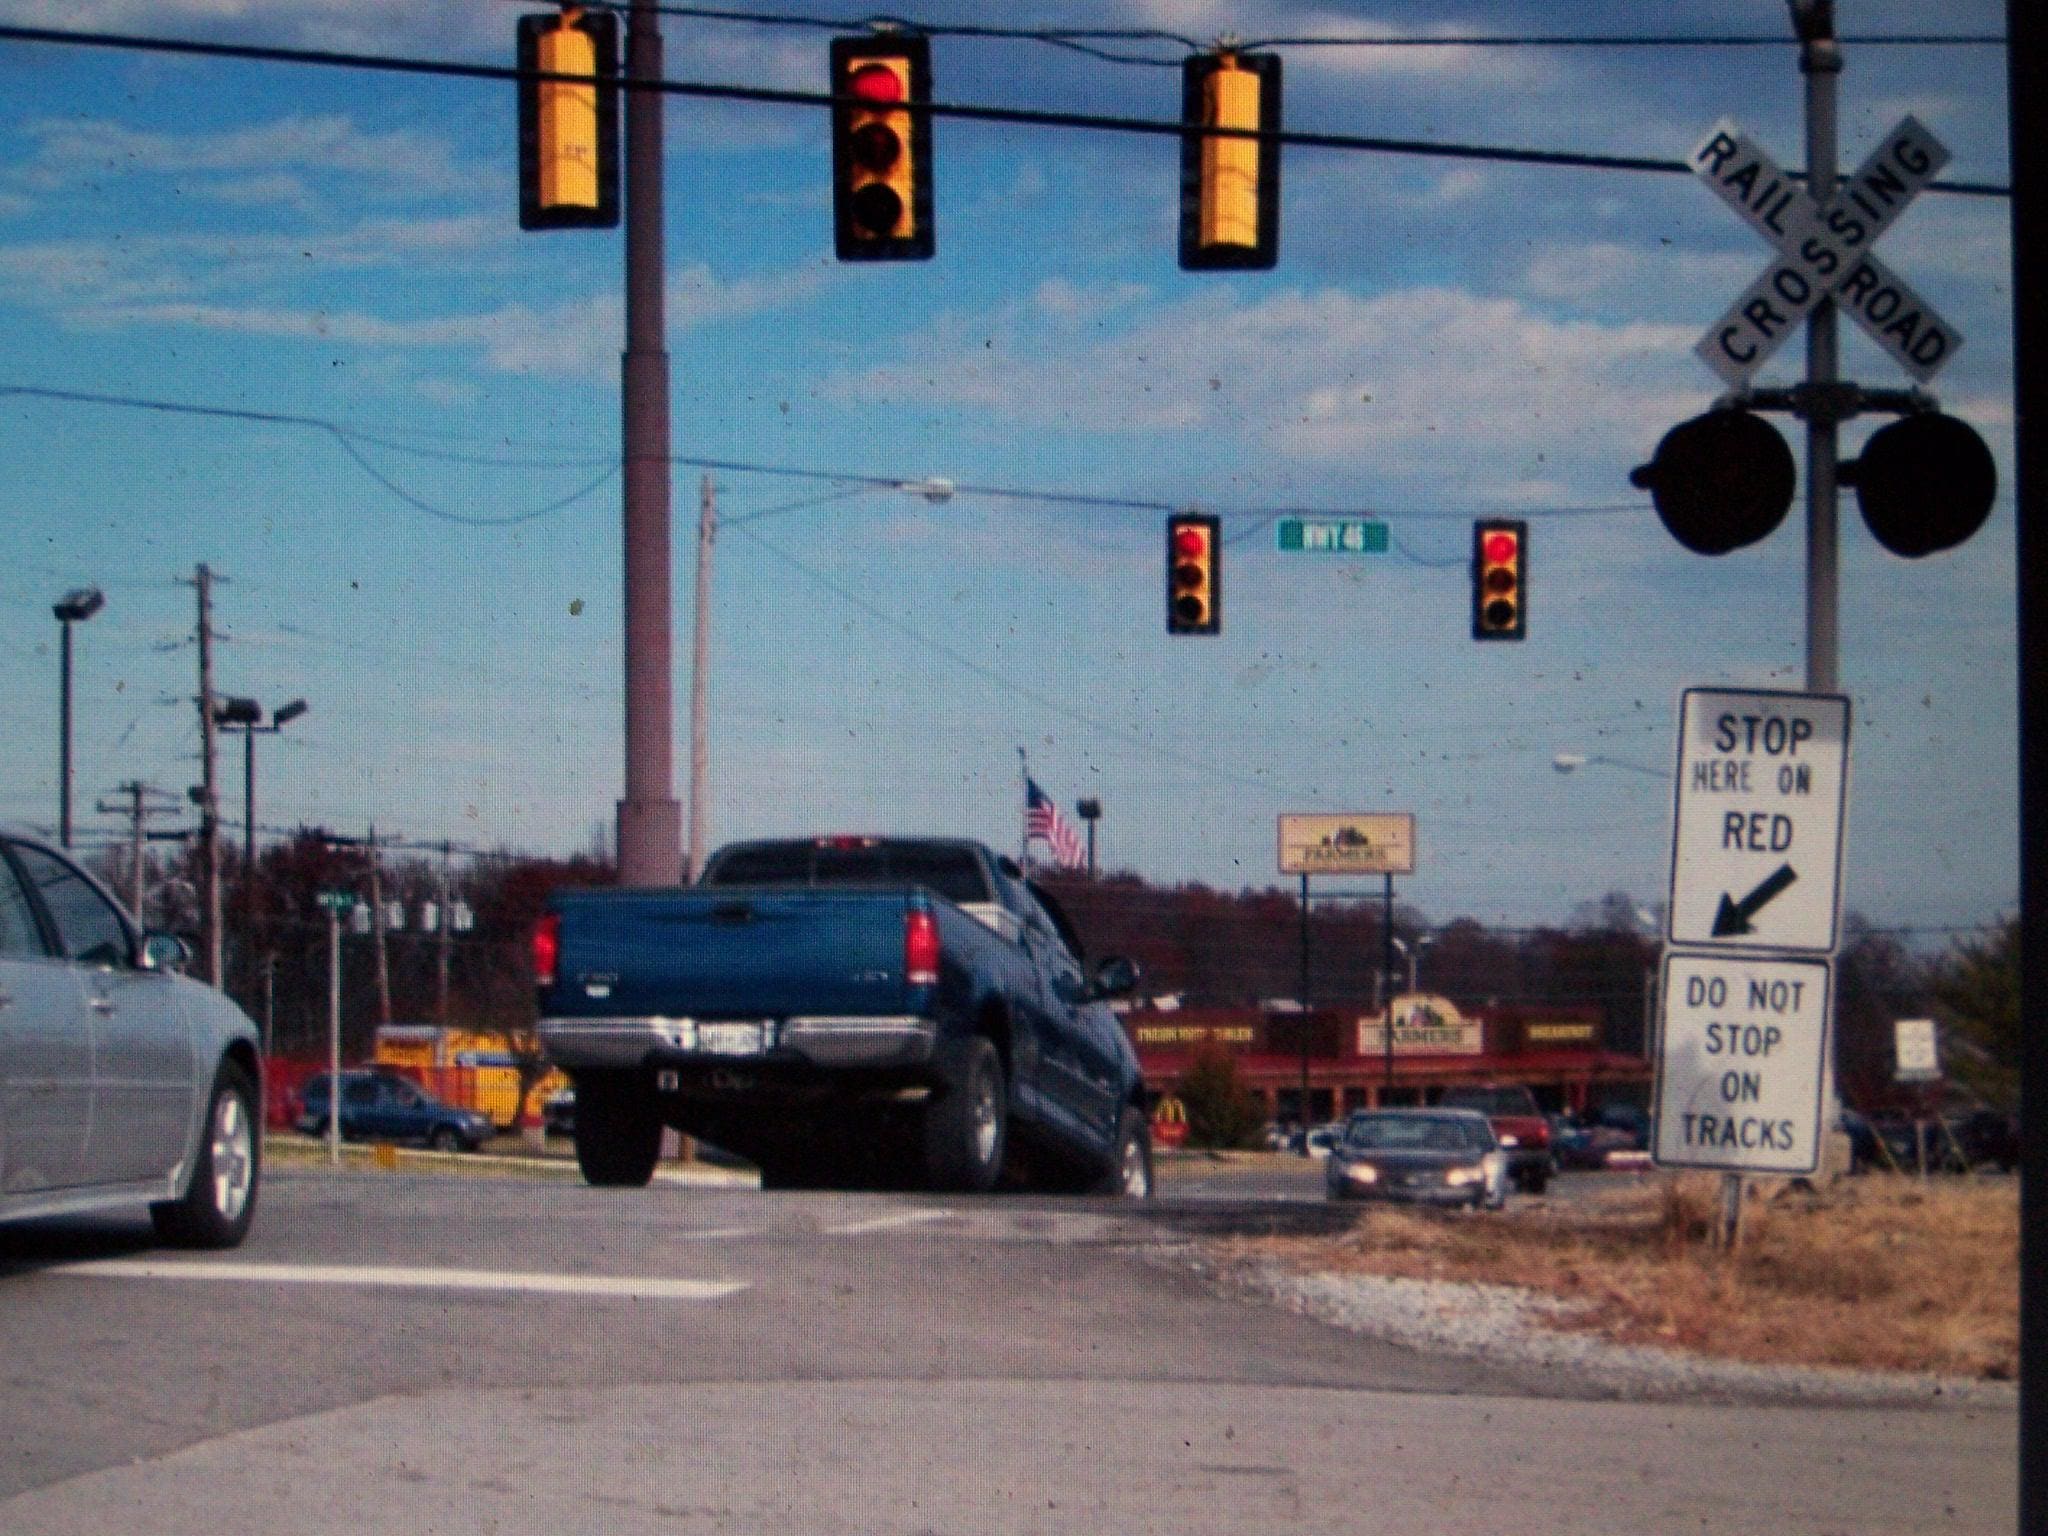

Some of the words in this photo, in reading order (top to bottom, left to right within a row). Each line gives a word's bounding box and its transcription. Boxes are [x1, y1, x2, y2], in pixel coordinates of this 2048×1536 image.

[1697, 132, 1793, 236] RAIL
[1839, 263, 1946, 367] ROAD
[1719, 138, 1930, 364] CROSSING
[1714, 713, 1813, 755] STOP
[1692, 760, 1753, 793] HERE
[1777, 762, 1811, 795] ON
[1723, 811, 1793, 852] RED
[1687, 976, 1727, 1008] DO
[1749, 979, 1805, 1014] NOT
[1705, 1023, 1781, 1056] STOP
[1720, 1070, 1760, 1103] ON
[1682, 1113, 1794, 1150] TRACKS
